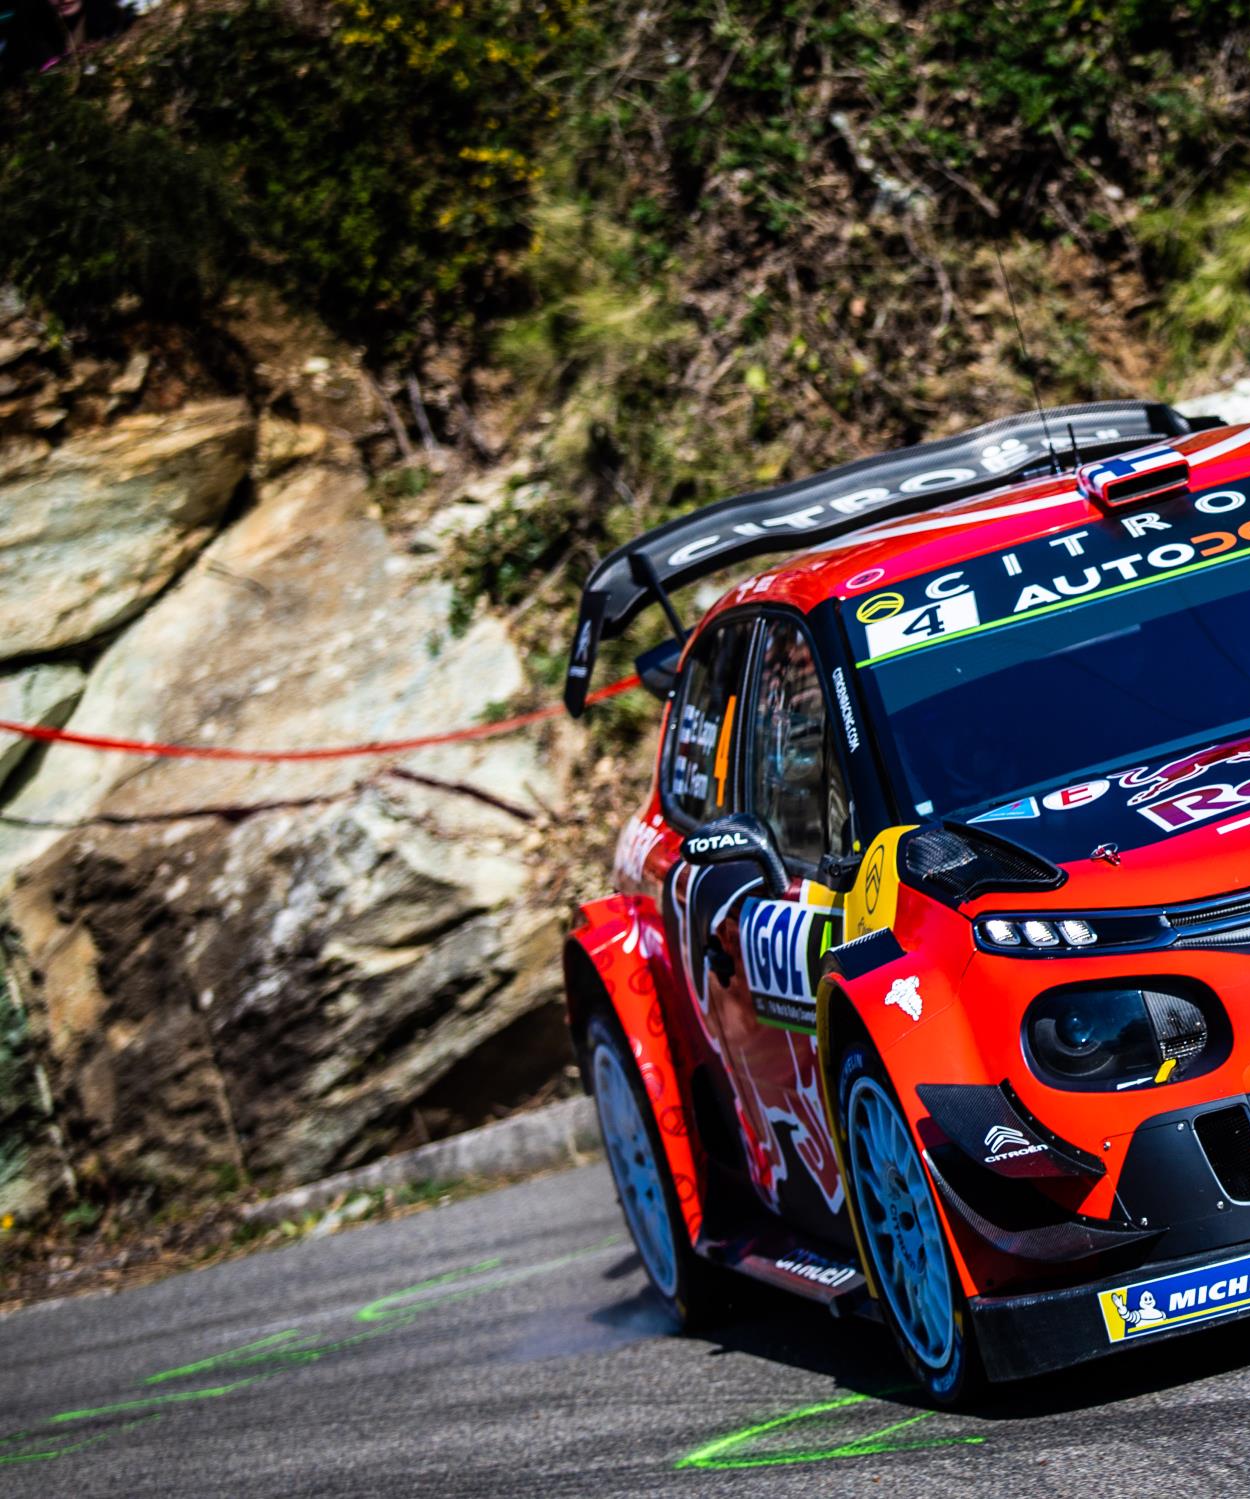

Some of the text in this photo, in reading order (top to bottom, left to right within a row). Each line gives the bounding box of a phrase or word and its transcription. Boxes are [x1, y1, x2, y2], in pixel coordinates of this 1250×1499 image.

[903, 604, 945, 636] 4
[687, 831, 749, 854] TOTAL
[746, 902, 807, 996] IGOL
